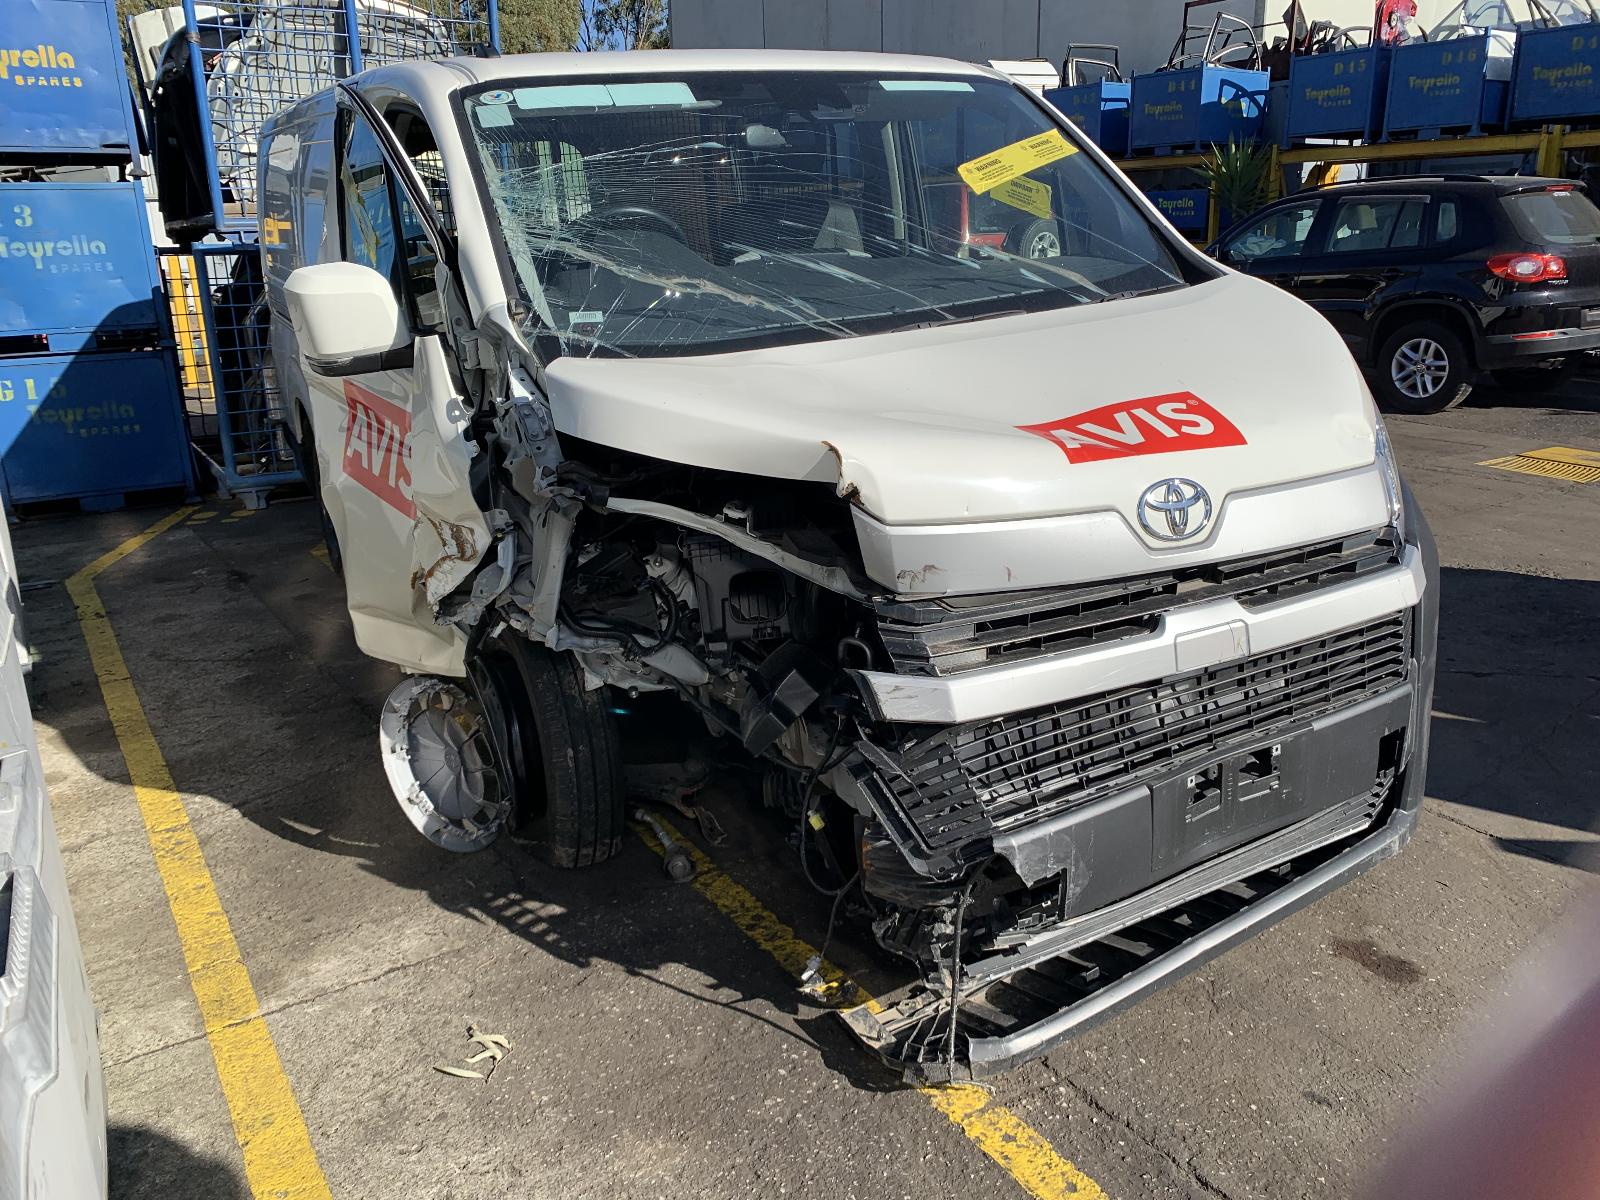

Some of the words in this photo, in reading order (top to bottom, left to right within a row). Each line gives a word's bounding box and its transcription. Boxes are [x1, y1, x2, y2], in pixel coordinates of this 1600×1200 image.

[15, 75, 83, 88] SPARES
[974, 158, 1002, 172] WARNING
[1158, 197, 1194, 214] Toyrolla
[49, 262, 114, 274] SPARES
[1049, 401, 1215, 450] AVIS
